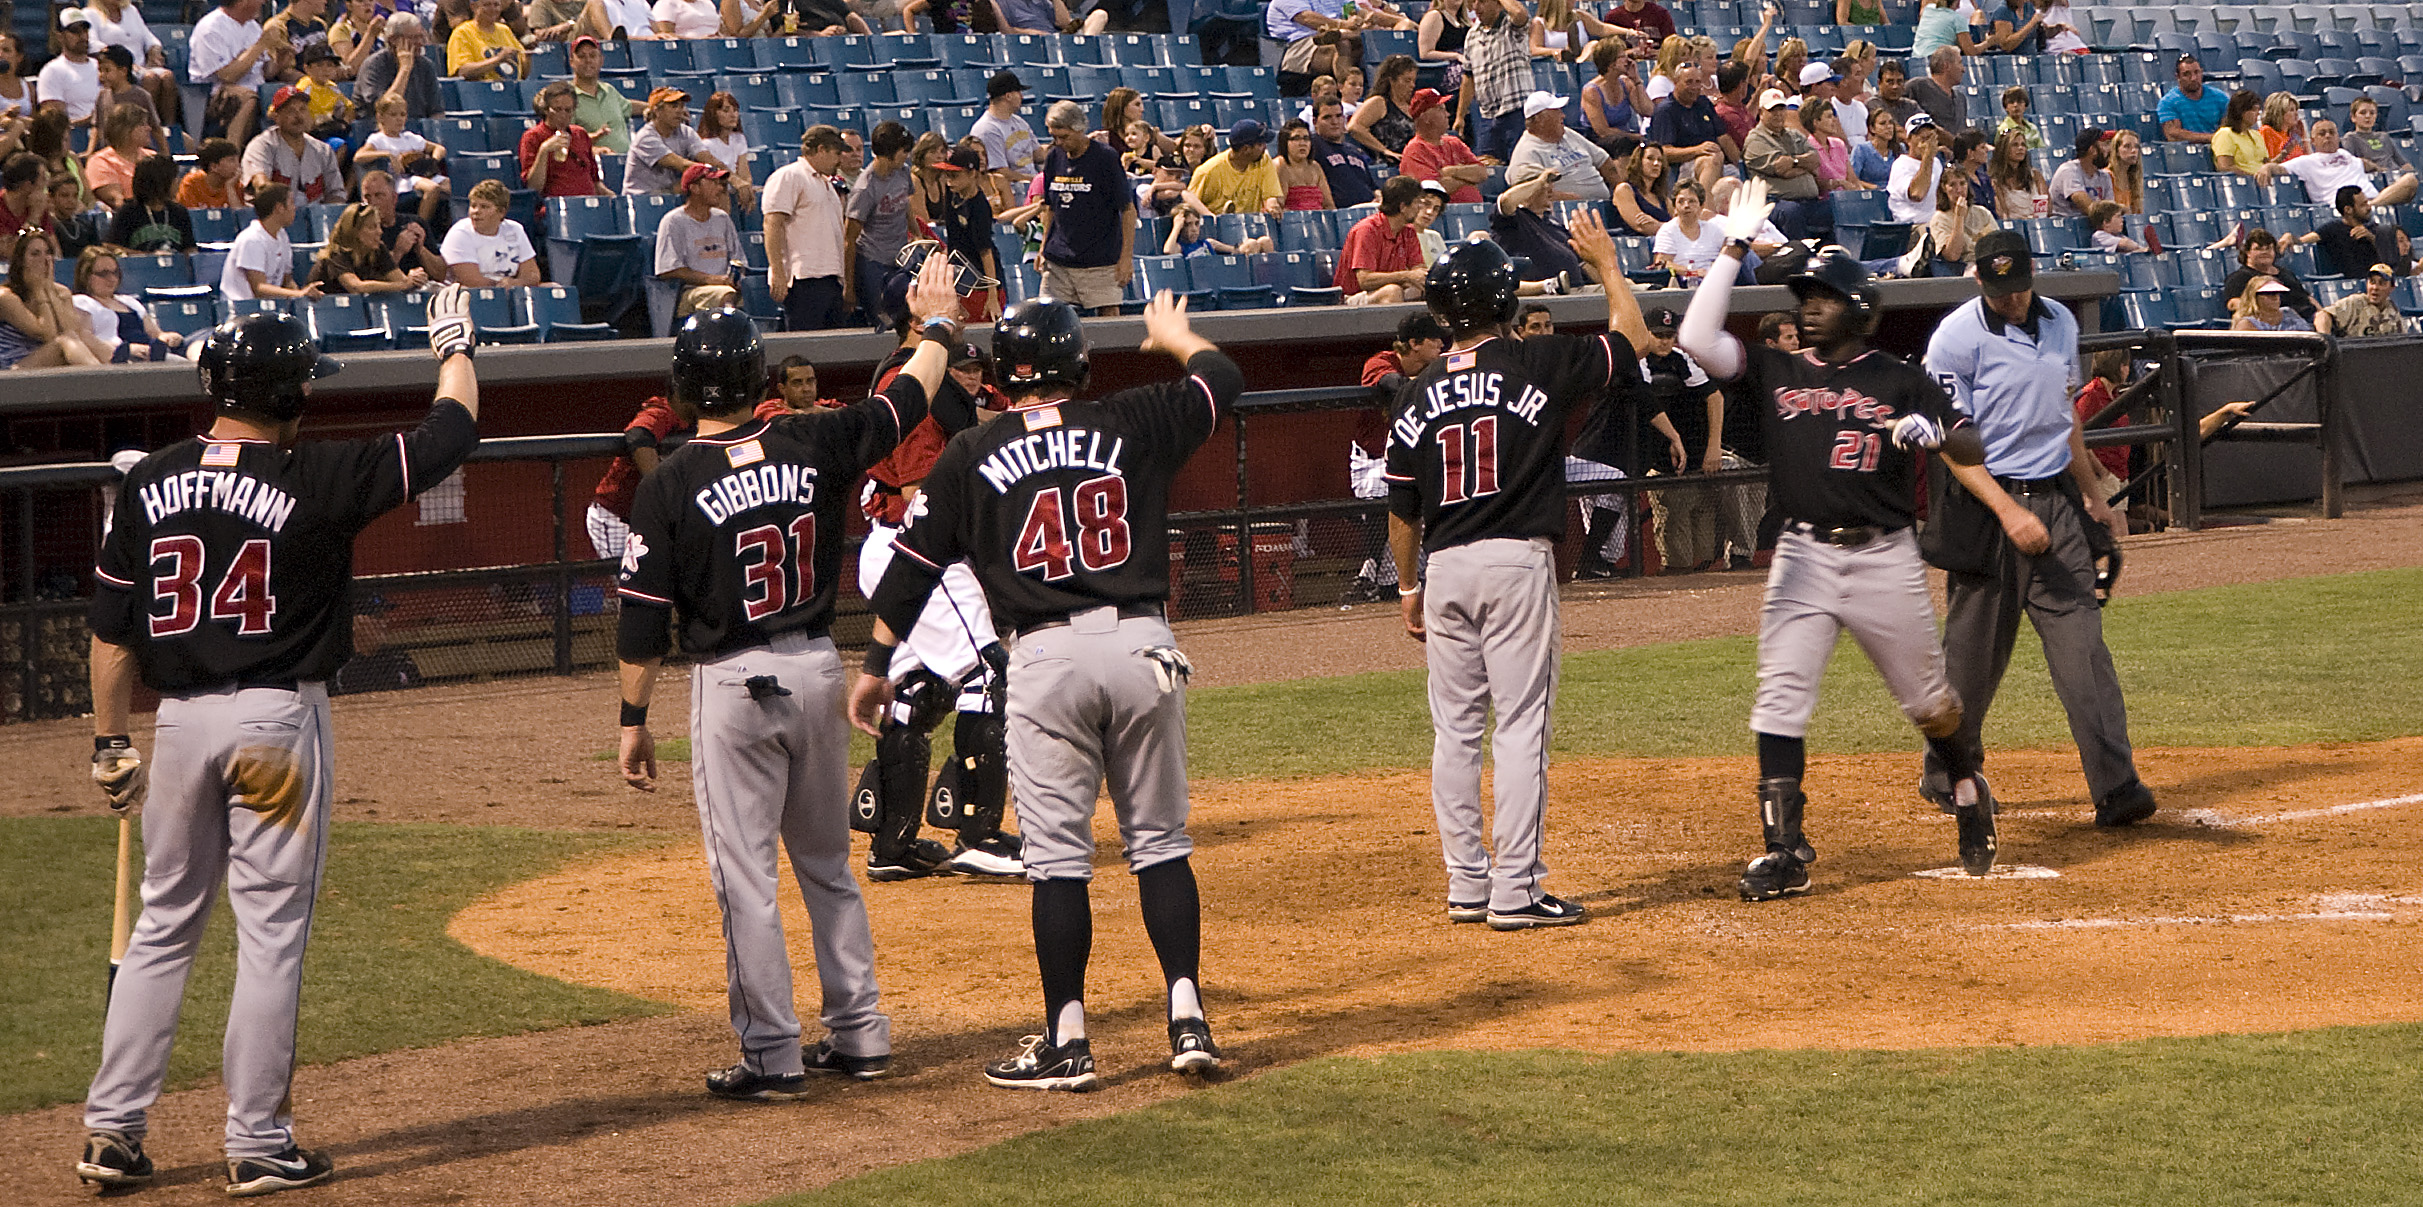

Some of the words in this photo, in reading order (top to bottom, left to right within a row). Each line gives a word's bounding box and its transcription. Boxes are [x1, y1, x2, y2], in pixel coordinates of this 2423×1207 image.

[1425, 372, 1504, 419] JESUS
[1506, 383, 1549, 427] JR.
[978, 429, 1124, 496] MITCHELL
[1435, 415, 1502, 507] 11
[1829, 430, 1882, 472] 21
[139, 470, 297, 533] HOFFMANN
[695, 463, 818, 528] GIBBONS
[1013, 474, 1132, 582] 48
[148, 534, 277, 638] 34
[735, 511, 817, 622] 31
